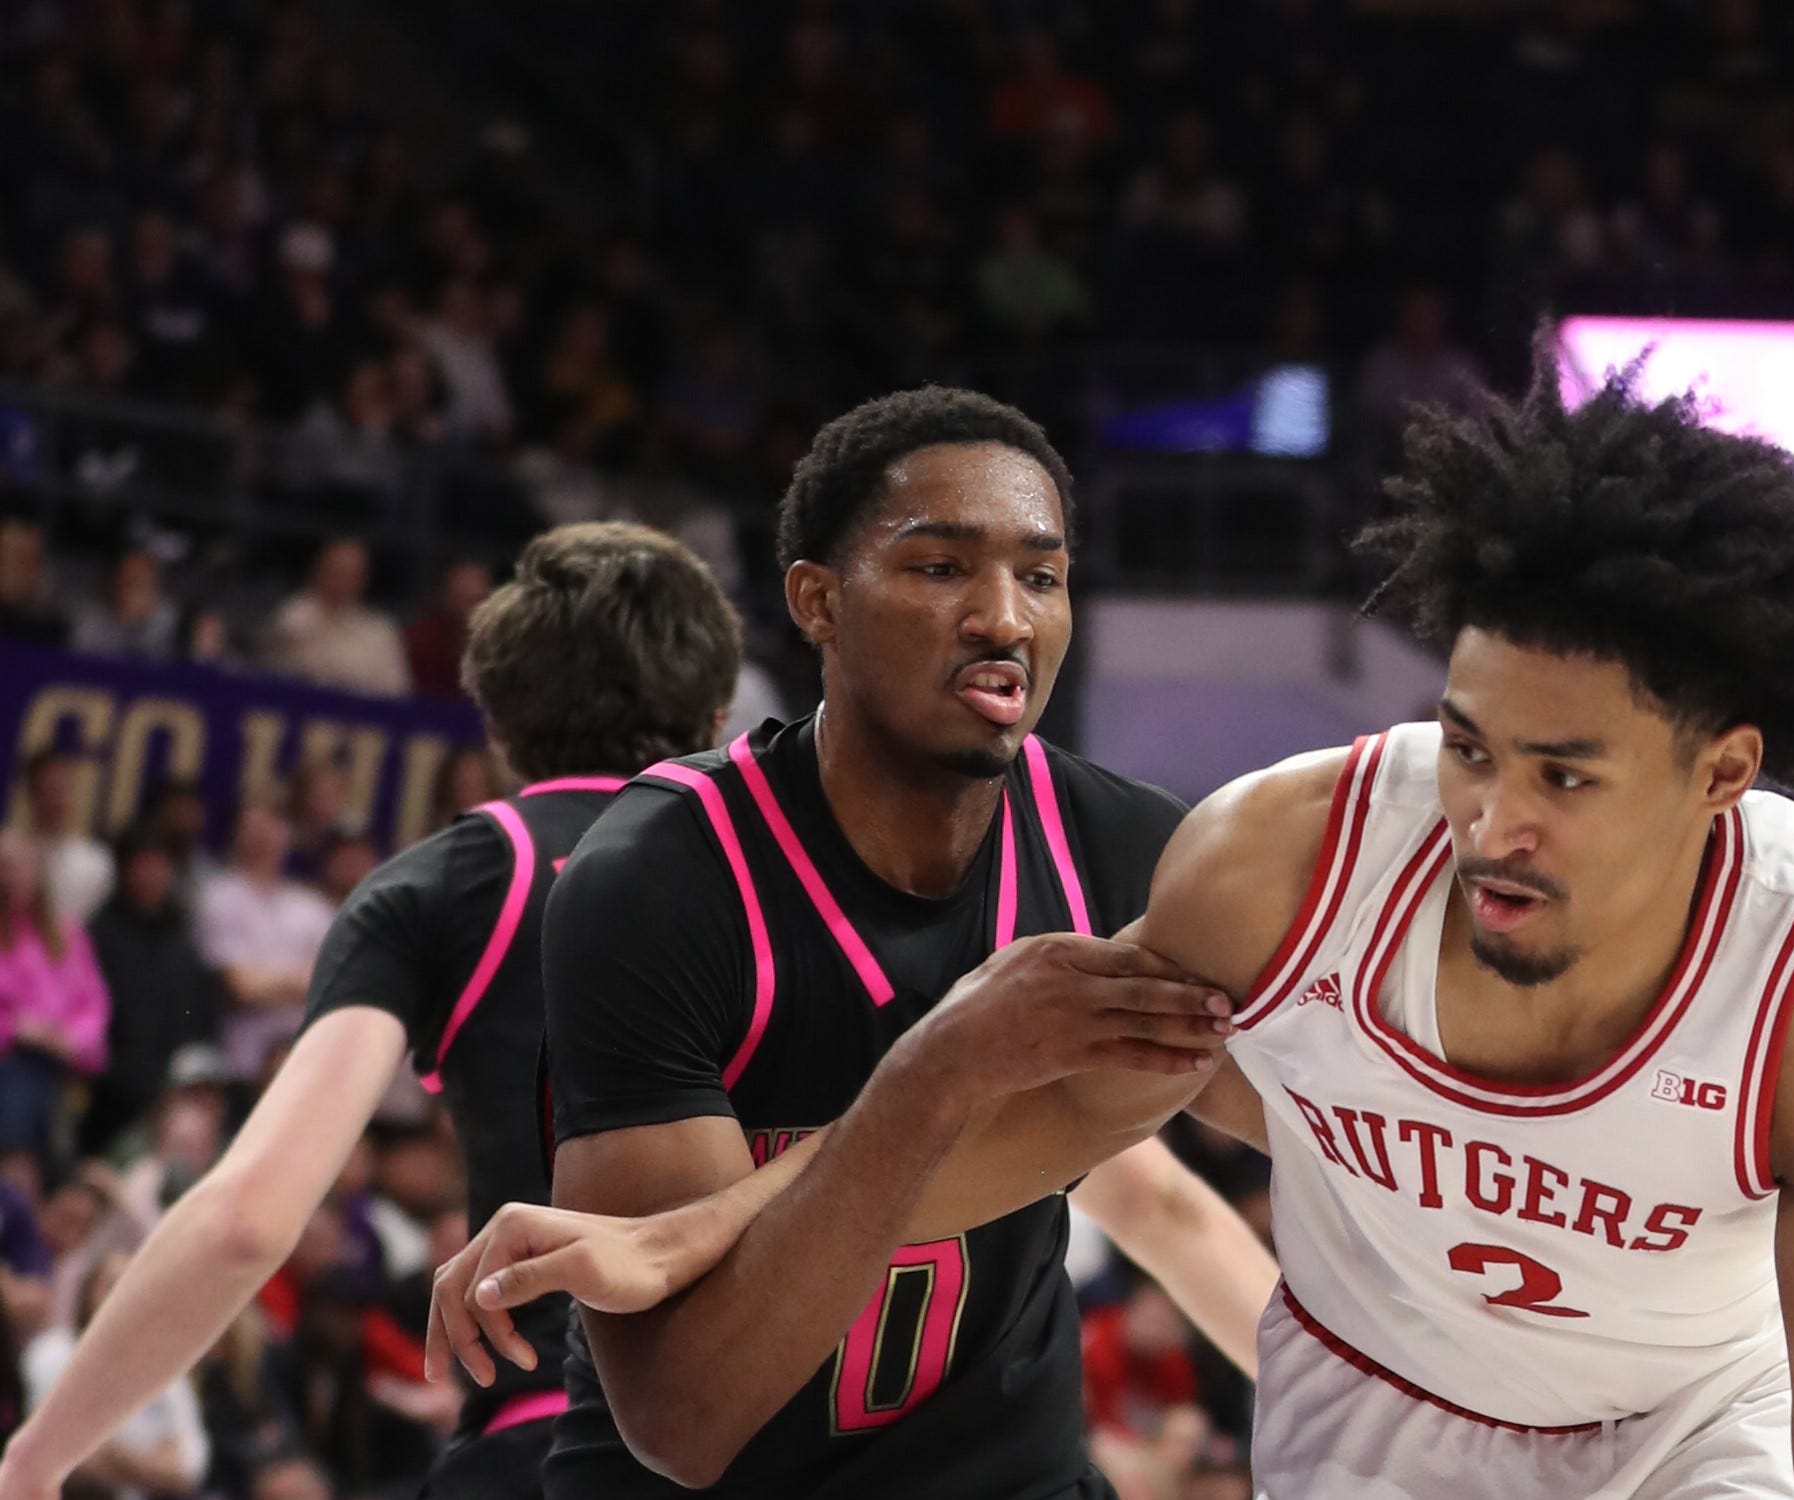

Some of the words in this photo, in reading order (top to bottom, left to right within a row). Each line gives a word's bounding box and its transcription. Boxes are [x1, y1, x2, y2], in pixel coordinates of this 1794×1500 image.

[1282, 1083, 1703, 1252] RUTGERS
[829, 1231, 971, 1437] 0
[1447, 1242, 1591, 1318] 2
